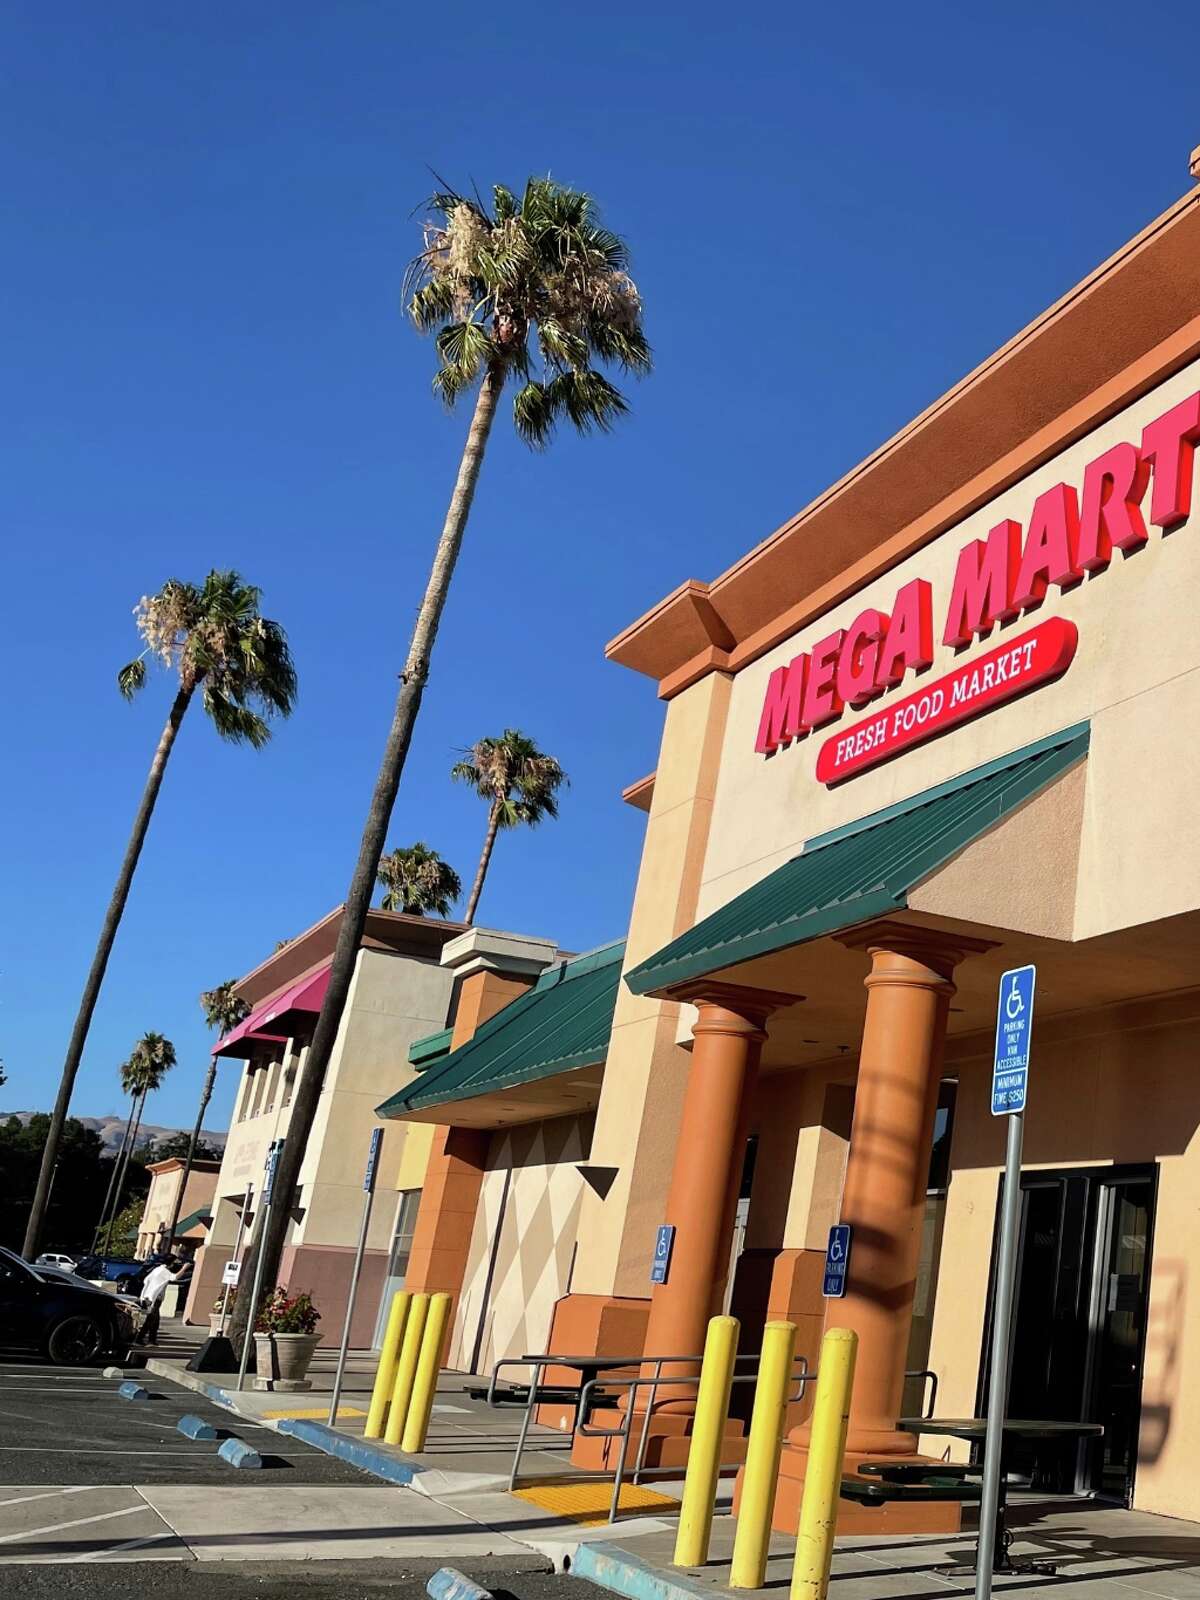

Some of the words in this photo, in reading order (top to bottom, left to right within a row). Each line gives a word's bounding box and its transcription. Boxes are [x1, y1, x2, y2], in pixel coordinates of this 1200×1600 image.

[754, 577, 934, 756] MEGA
[834, 718, 888, 767] FRESH
[892, 691, 944, 737] FOOD
[949, 639, 1038, 708] MARKET
[1003, 1019, 1025, 1033] PARKING
[1007, 1032, 1020, 1045] ONLY
[997, 1054, 1027, 1070] ACCESSIBLE
[997, 1073, 1023, 1090] MINIMUM
